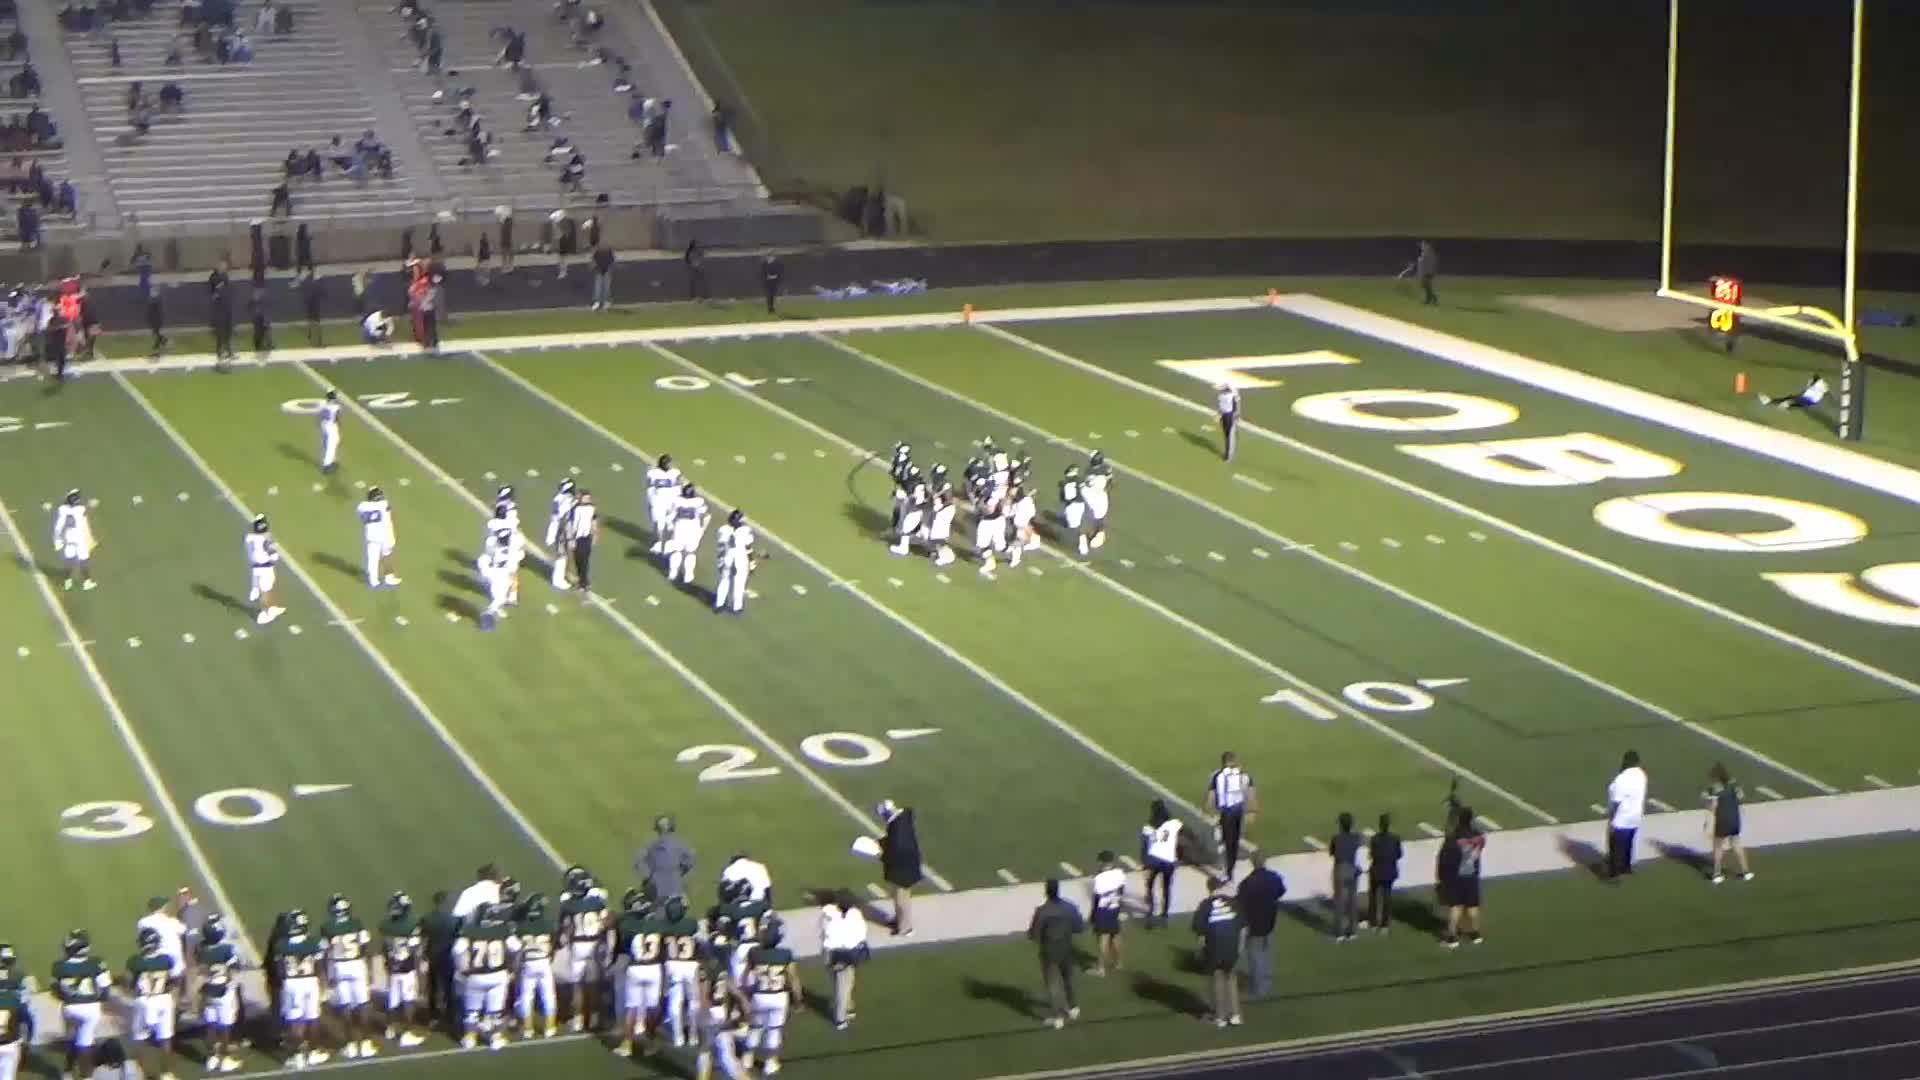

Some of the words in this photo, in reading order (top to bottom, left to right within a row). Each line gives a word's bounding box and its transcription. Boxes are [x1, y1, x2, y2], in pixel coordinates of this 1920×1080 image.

[1261, 682, 1434, 720] 10
[676, 731, 891, 782] 20
[60, 788, 287, 841] 30
